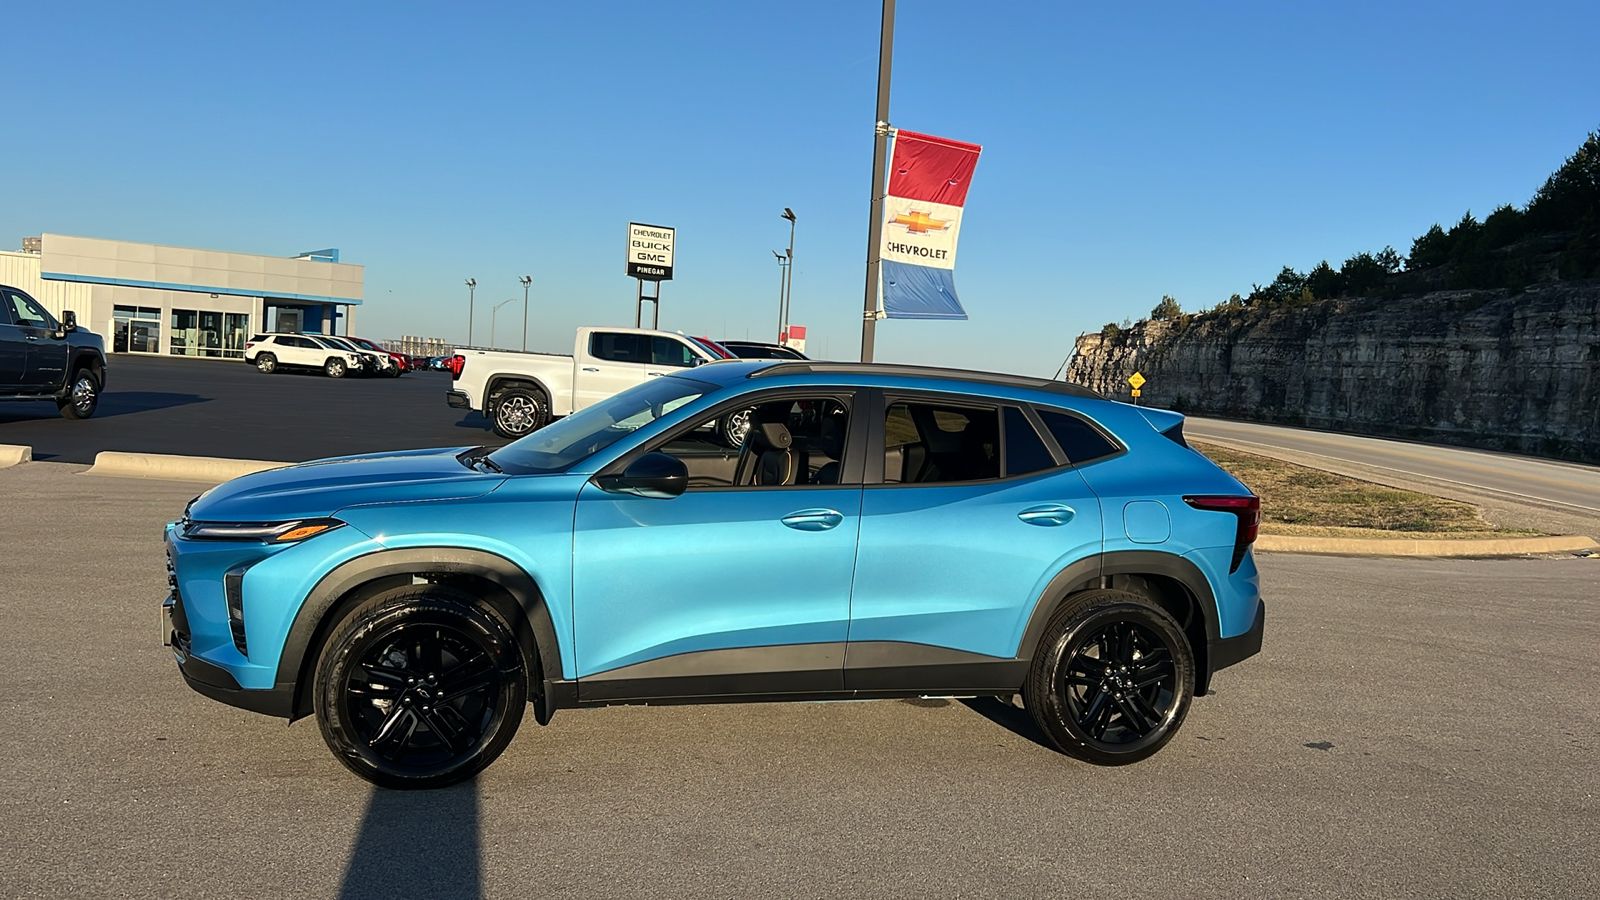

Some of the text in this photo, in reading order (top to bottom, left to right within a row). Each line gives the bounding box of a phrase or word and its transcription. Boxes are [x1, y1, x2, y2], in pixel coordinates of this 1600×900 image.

[633, 229, 671, 240] CHEVROLET
[632, 240, 671, 252] BUICK
[887, 241, 948, 260] CHEVROLET
[637, 252, 666, 263] GMC
[636, 266, 665, 275] PINEGAR
